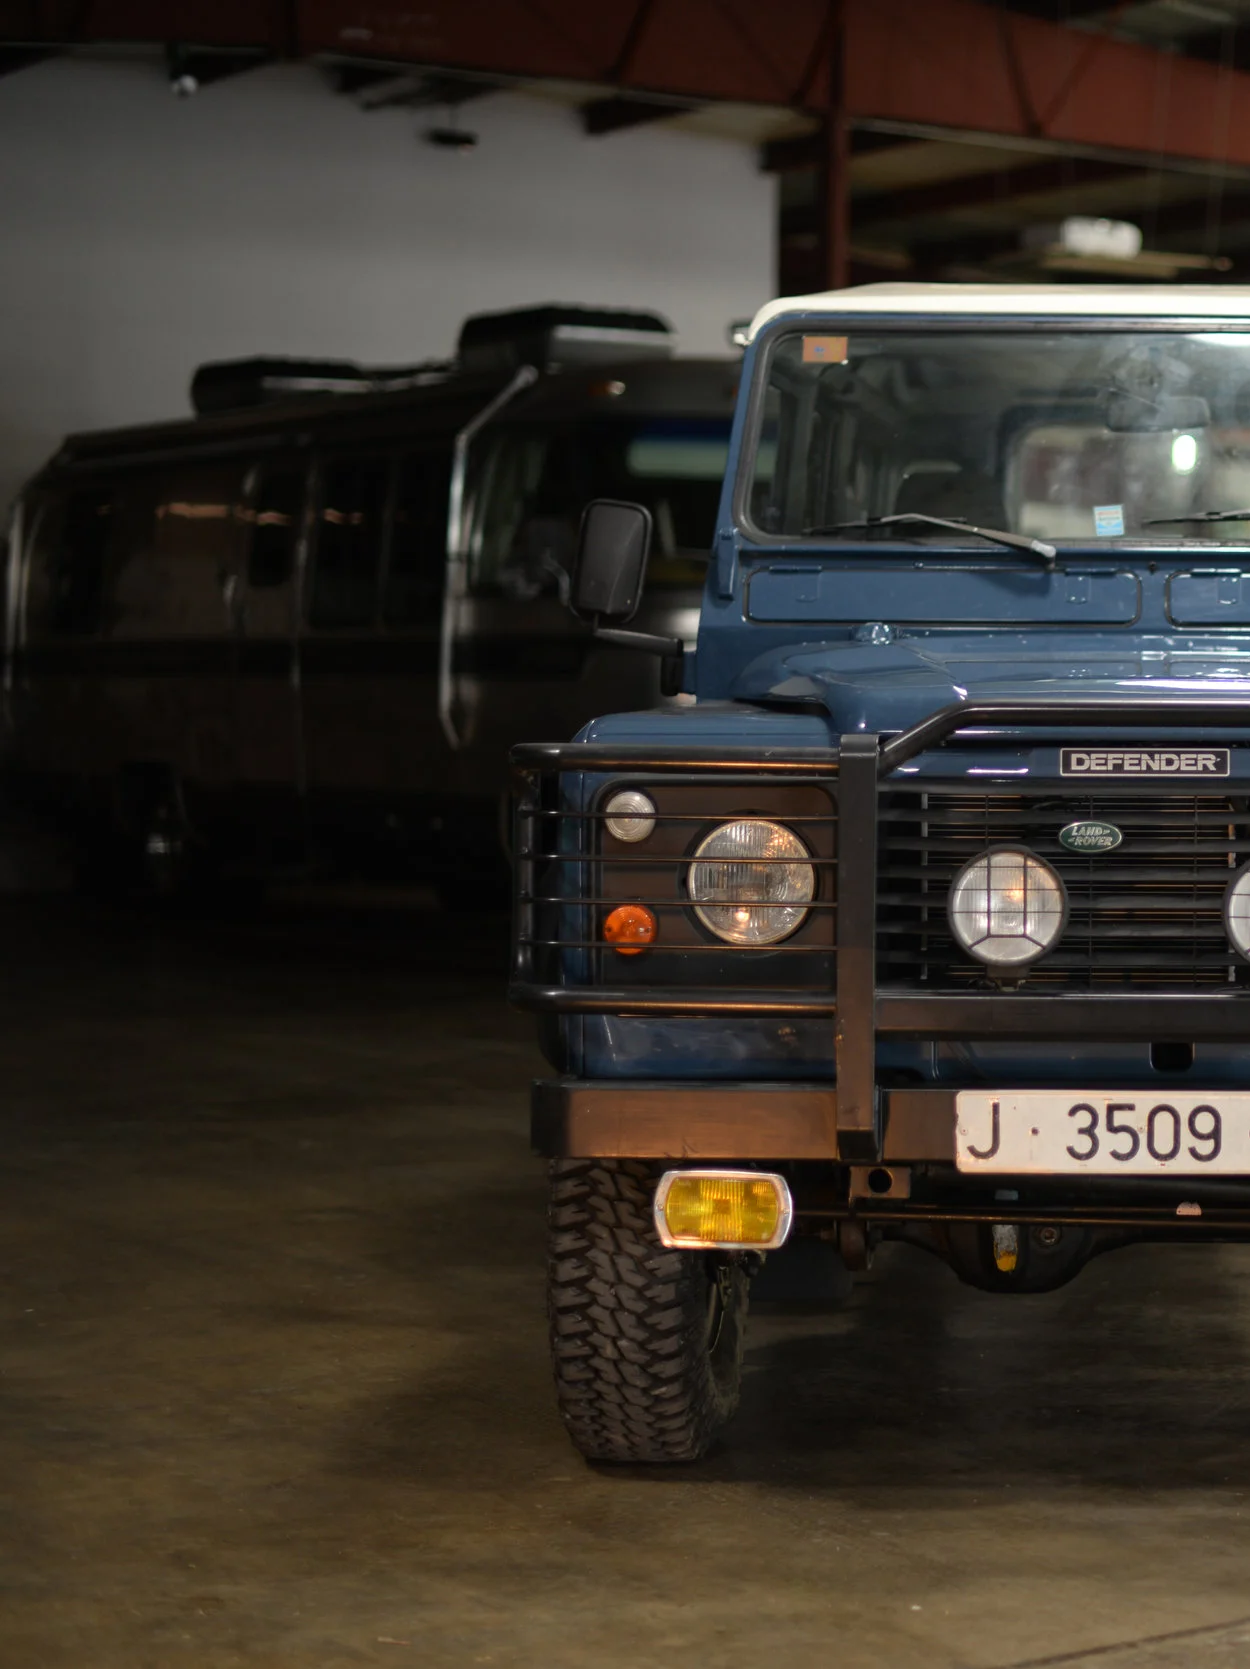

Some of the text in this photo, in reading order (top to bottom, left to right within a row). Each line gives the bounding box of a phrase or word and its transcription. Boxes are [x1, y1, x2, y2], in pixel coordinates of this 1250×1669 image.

[1071, 753, 1217, 771] DEFENDER
[1072, 826, 1103, 836] LAND
[1074, 836, 1113, 846] ROVER
[966, 1102, 1000, 1159] J
[1066, 1103, 1222, 1162] 3509
